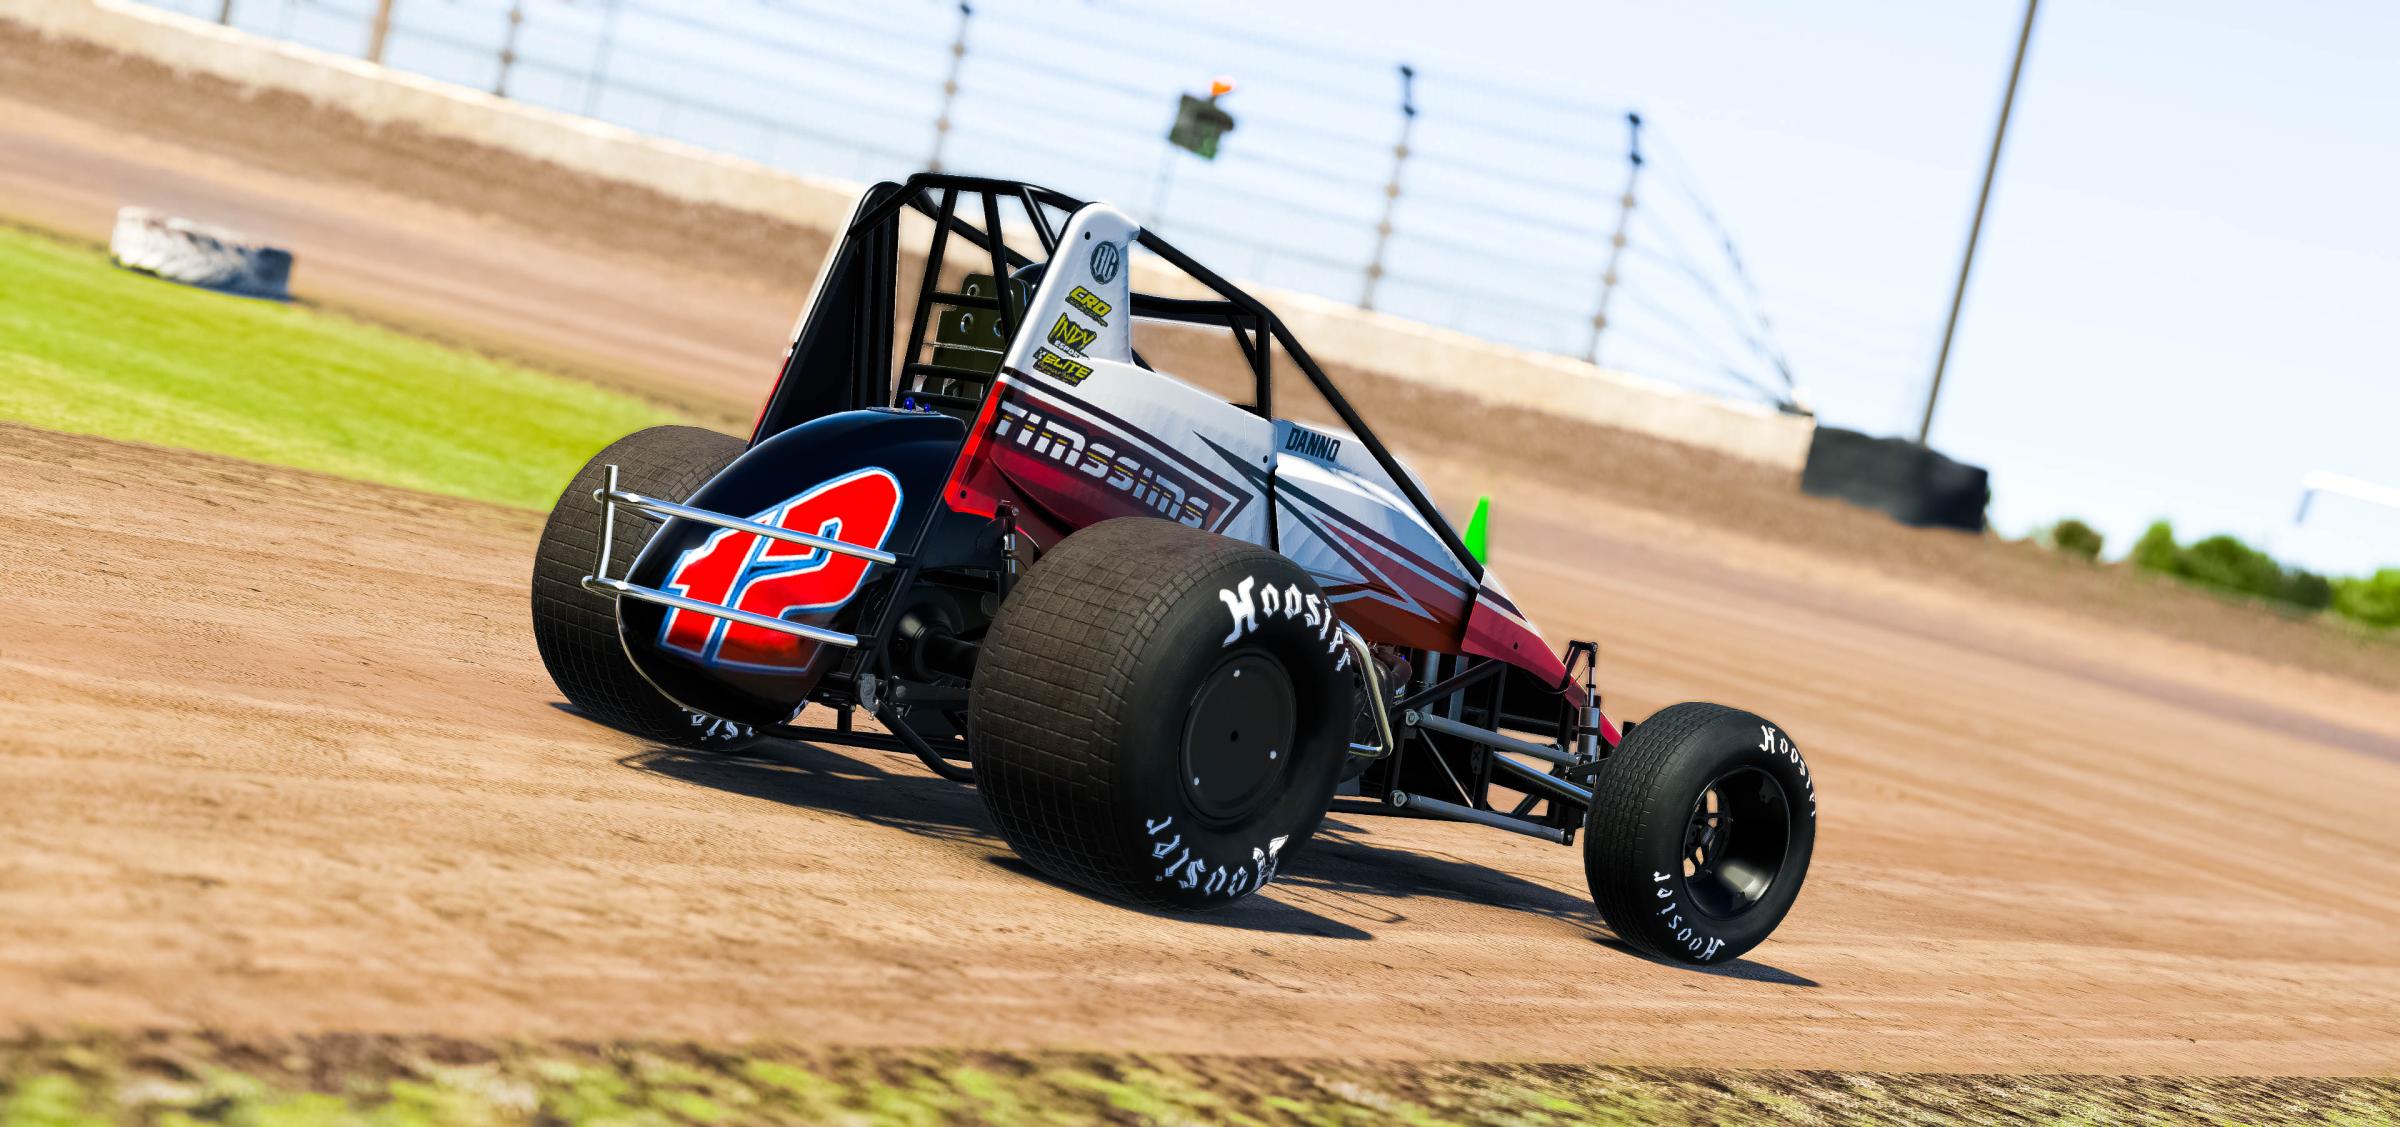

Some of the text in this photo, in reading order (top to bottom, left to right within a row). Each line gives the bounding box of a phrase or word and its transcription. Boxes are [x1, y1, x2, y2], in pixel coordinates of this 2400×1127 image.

[1050, 313, 1096, 349] INDY
[1285, 427, 1341, 462] DANNO
[656, 466, 904, 674] 12
[1219, 575, 1351, 671] Hoosier
[1146, 816, 1289, 896] Hoosier
[1653, 871, 1726, 961] Hoosier
